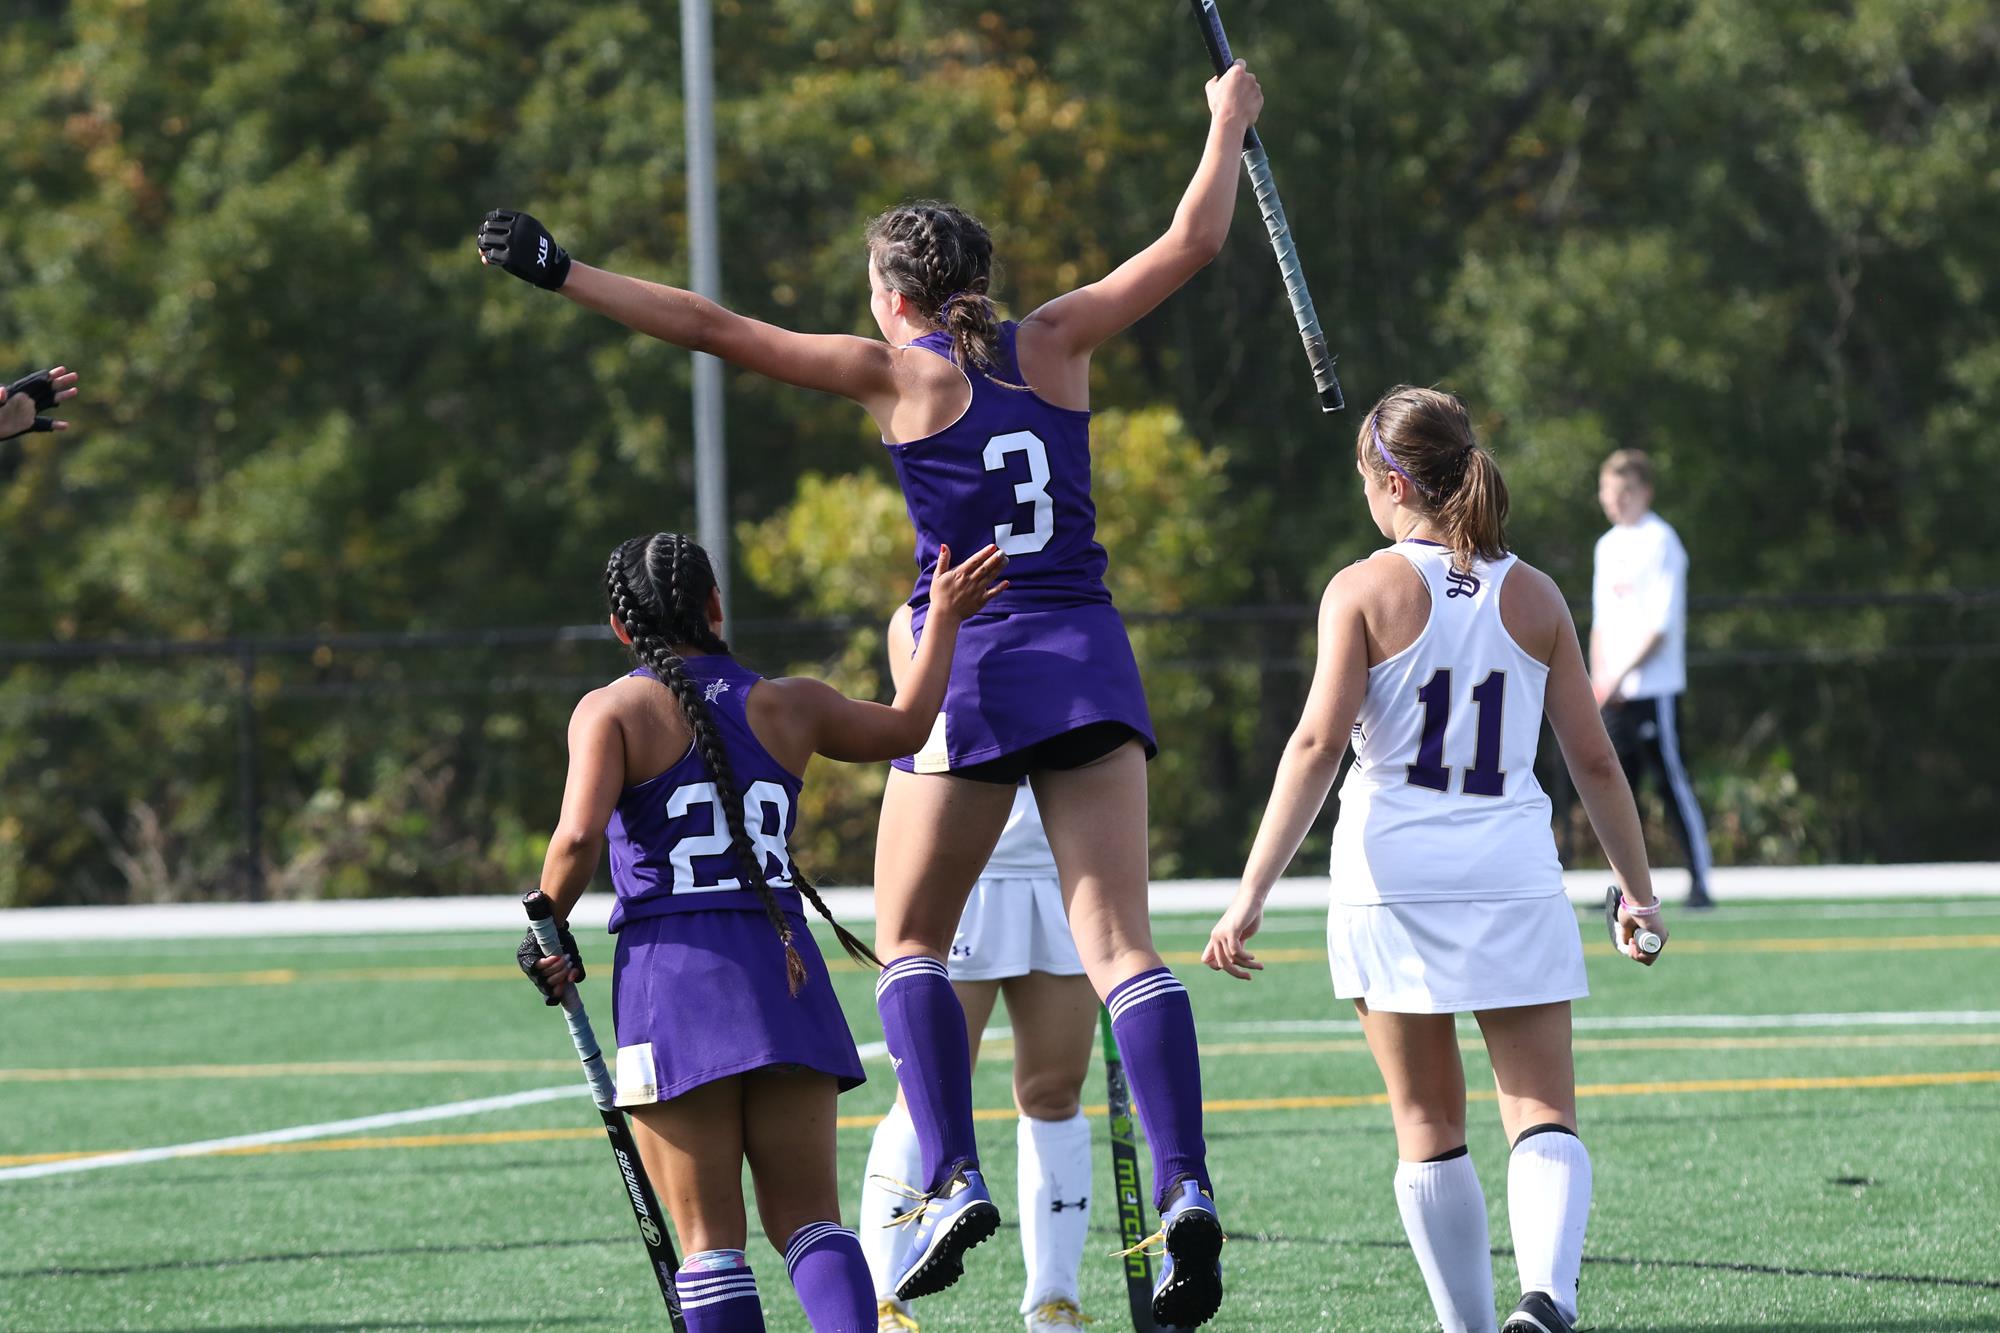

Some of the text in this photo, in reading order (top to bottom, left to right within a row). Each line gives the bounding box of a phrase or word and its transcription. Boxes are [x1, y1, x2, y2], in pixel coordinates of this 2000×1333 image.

[537, 235, 549, 268] STX
[982, 430, 1054, 556] 3
[1404, 667, 1508, 798] 11
[666, 780, 794, 895] 28
